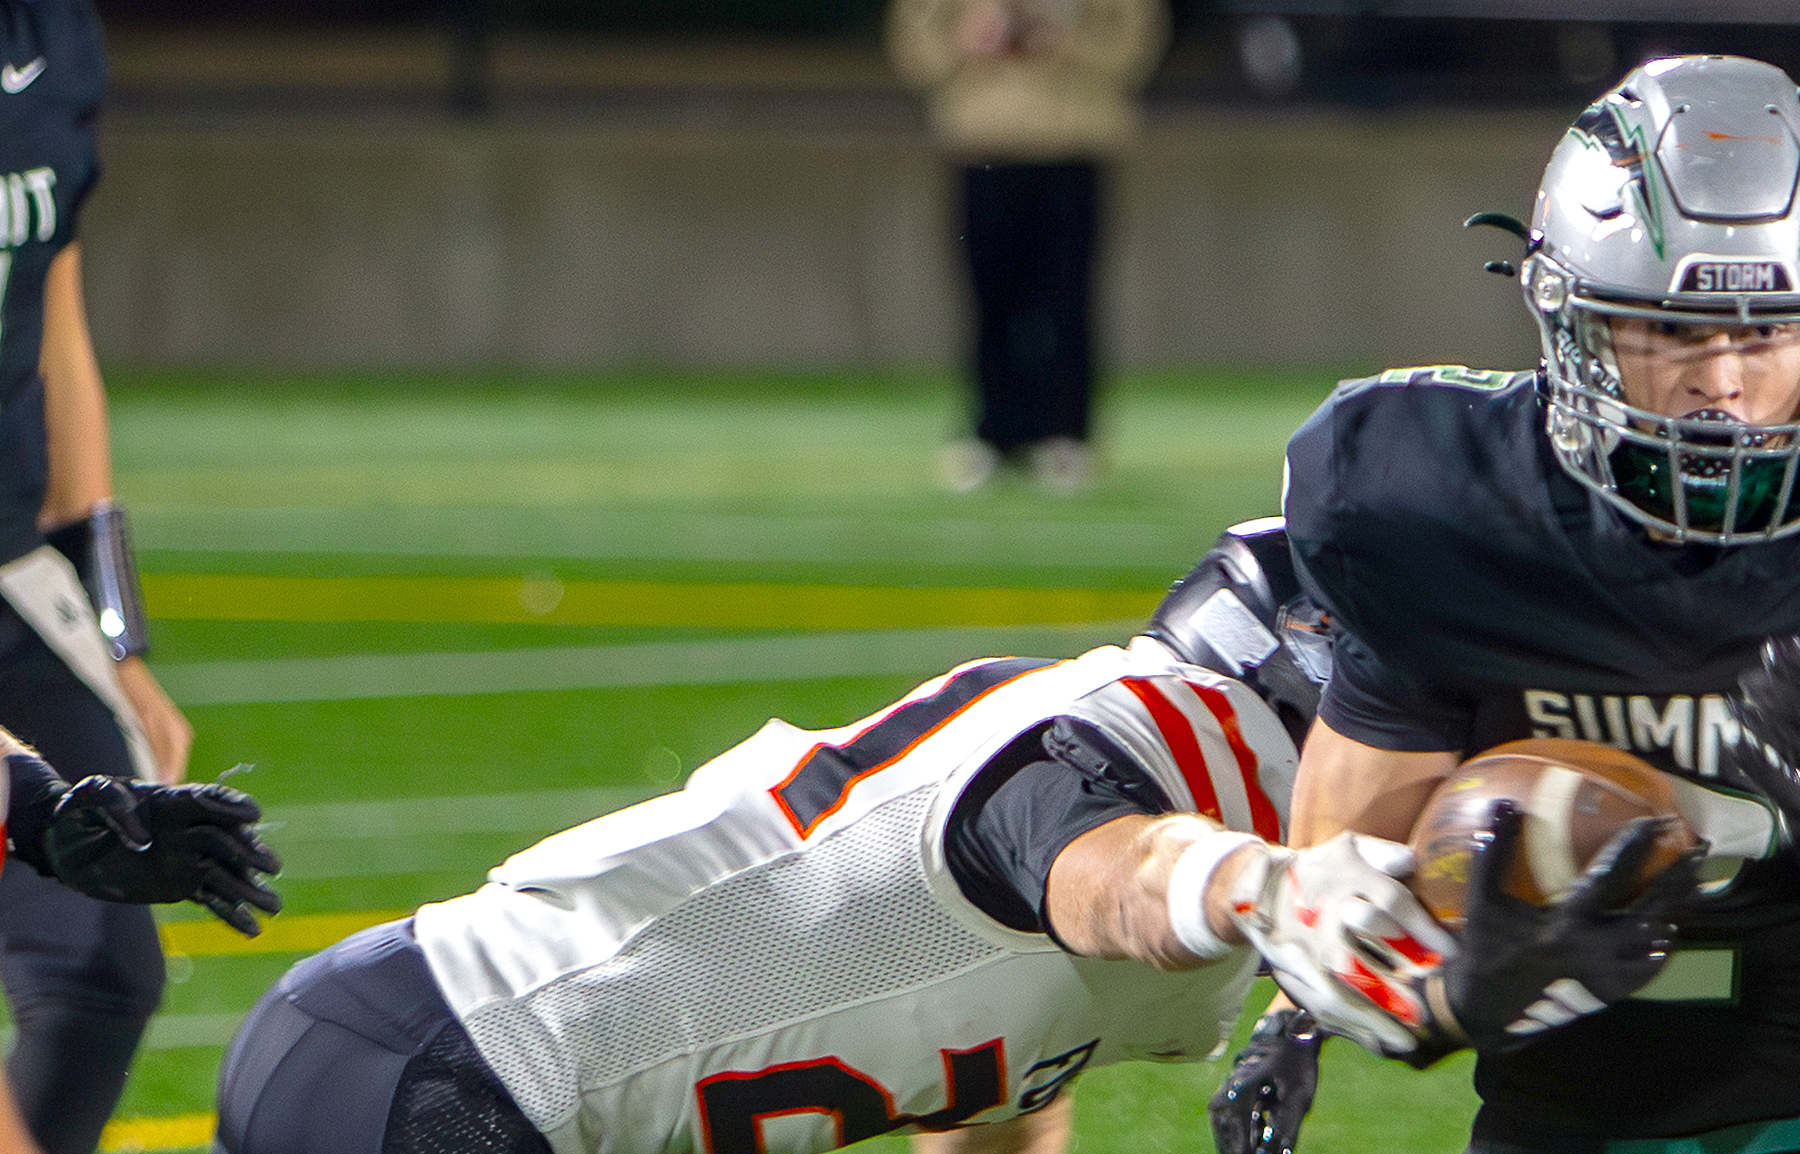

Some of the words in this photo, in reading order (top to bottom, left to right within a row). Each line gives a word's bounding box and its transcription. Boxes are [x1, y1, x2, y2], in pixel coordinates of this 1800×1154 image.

[0, 167, 57, 247] IT
[1696, 264, 1774, 291] STORM
[1523, 689, 1742, 778] SUMM
